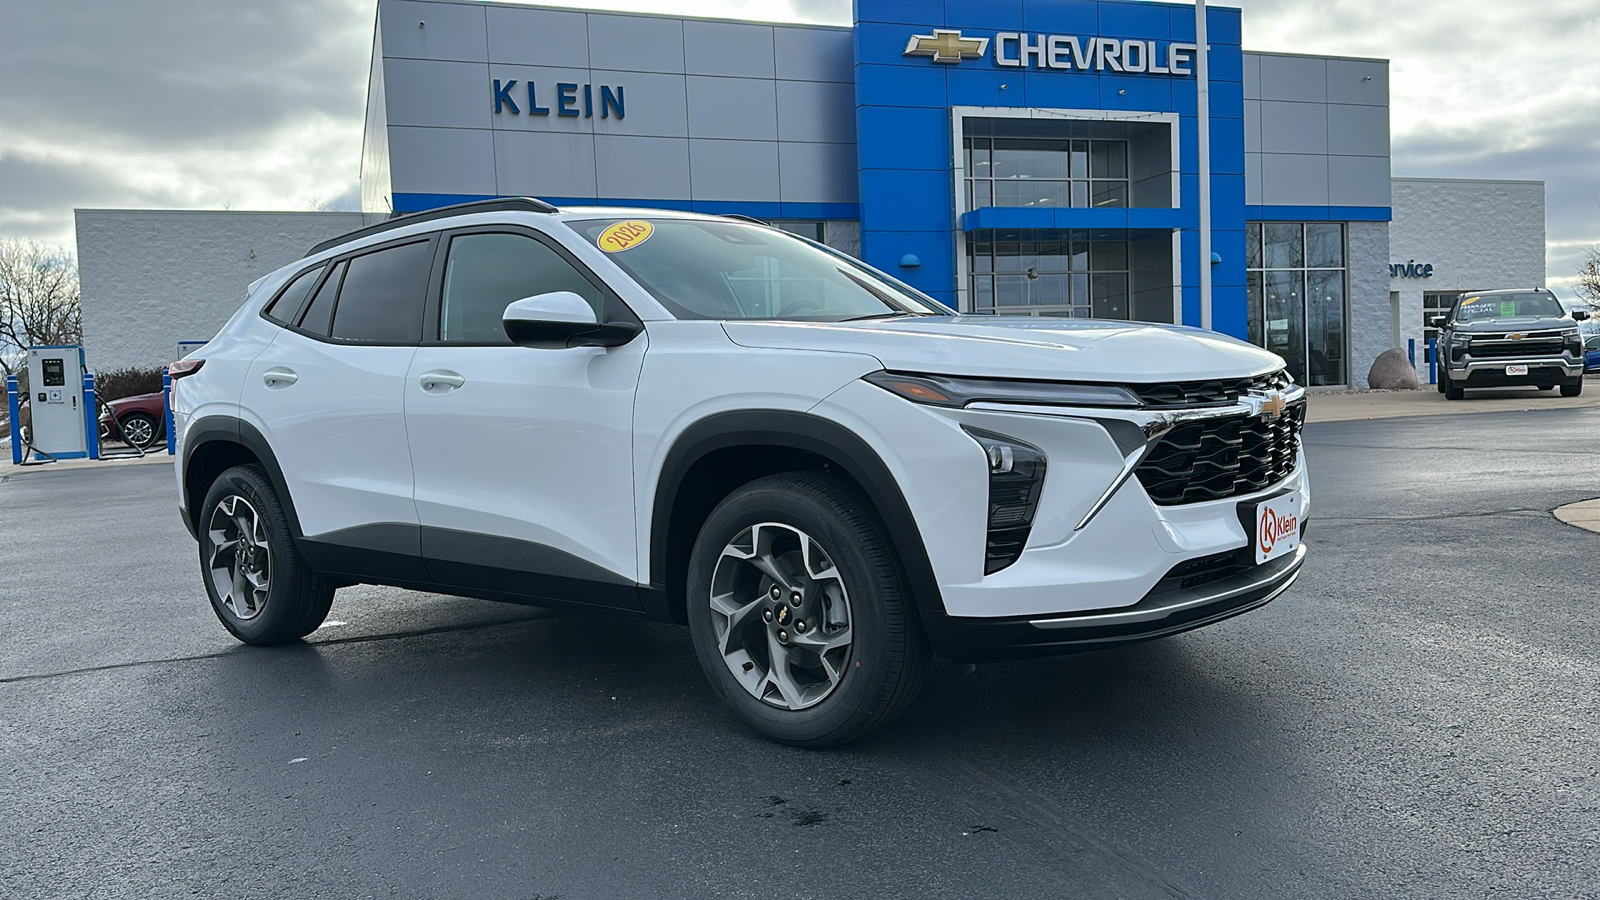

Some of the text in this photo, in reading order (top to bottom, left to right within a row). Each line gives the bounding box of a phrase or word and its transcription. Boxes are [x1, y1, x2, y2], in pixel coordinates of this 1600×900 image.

[493, 79, 625, 119] KLEIN
[606, 222, 646, 248] 2026
[1278, 513, 1297, 536] Klein
